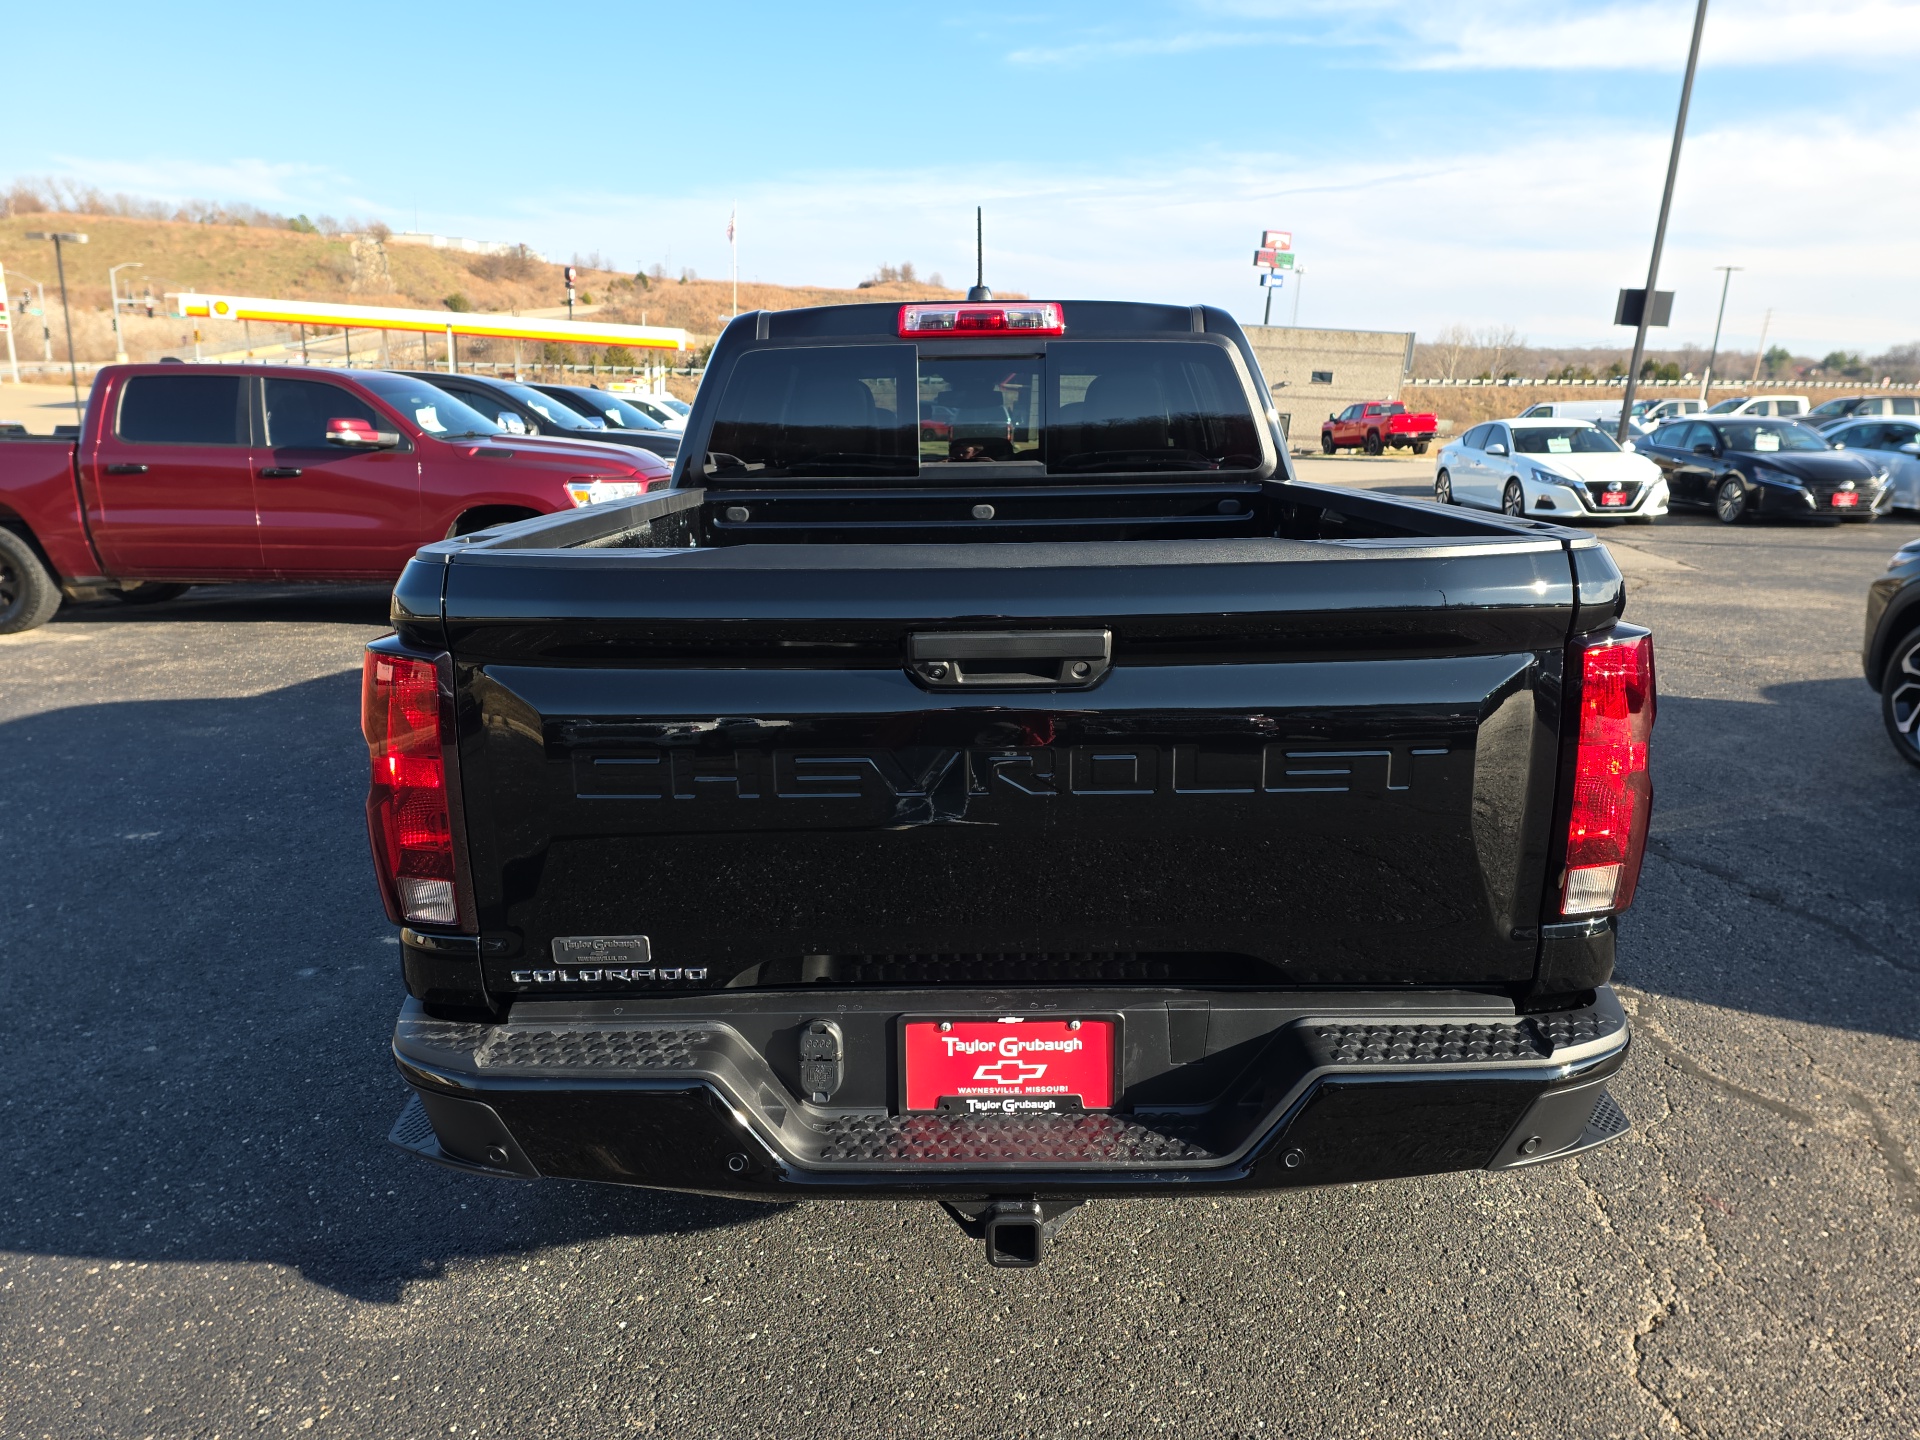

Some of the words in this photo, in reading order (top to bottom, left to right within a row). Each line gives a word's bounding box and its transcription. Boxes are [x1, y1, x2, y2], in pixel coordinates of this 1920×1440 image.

[571, 743, 1451, 800] CHEVROLET
[560, 940, 592, 952] Taylor
[592, 939, 641, 951] Grubaugh
[510, 967, 708, 983] COLORADO
[941, 1036, 996, 1057] Taylor
[999, 1037, 1083, 1057] Grubaugh
[957, 1086, 1023, 1094] WAYNESVILLE,
[1025, 1085, 1069, 1093] MISSOURI
[966, 1099, 1001, 1113] Taylor
[1002, 1099, 1056, 1113] Grubaugh
